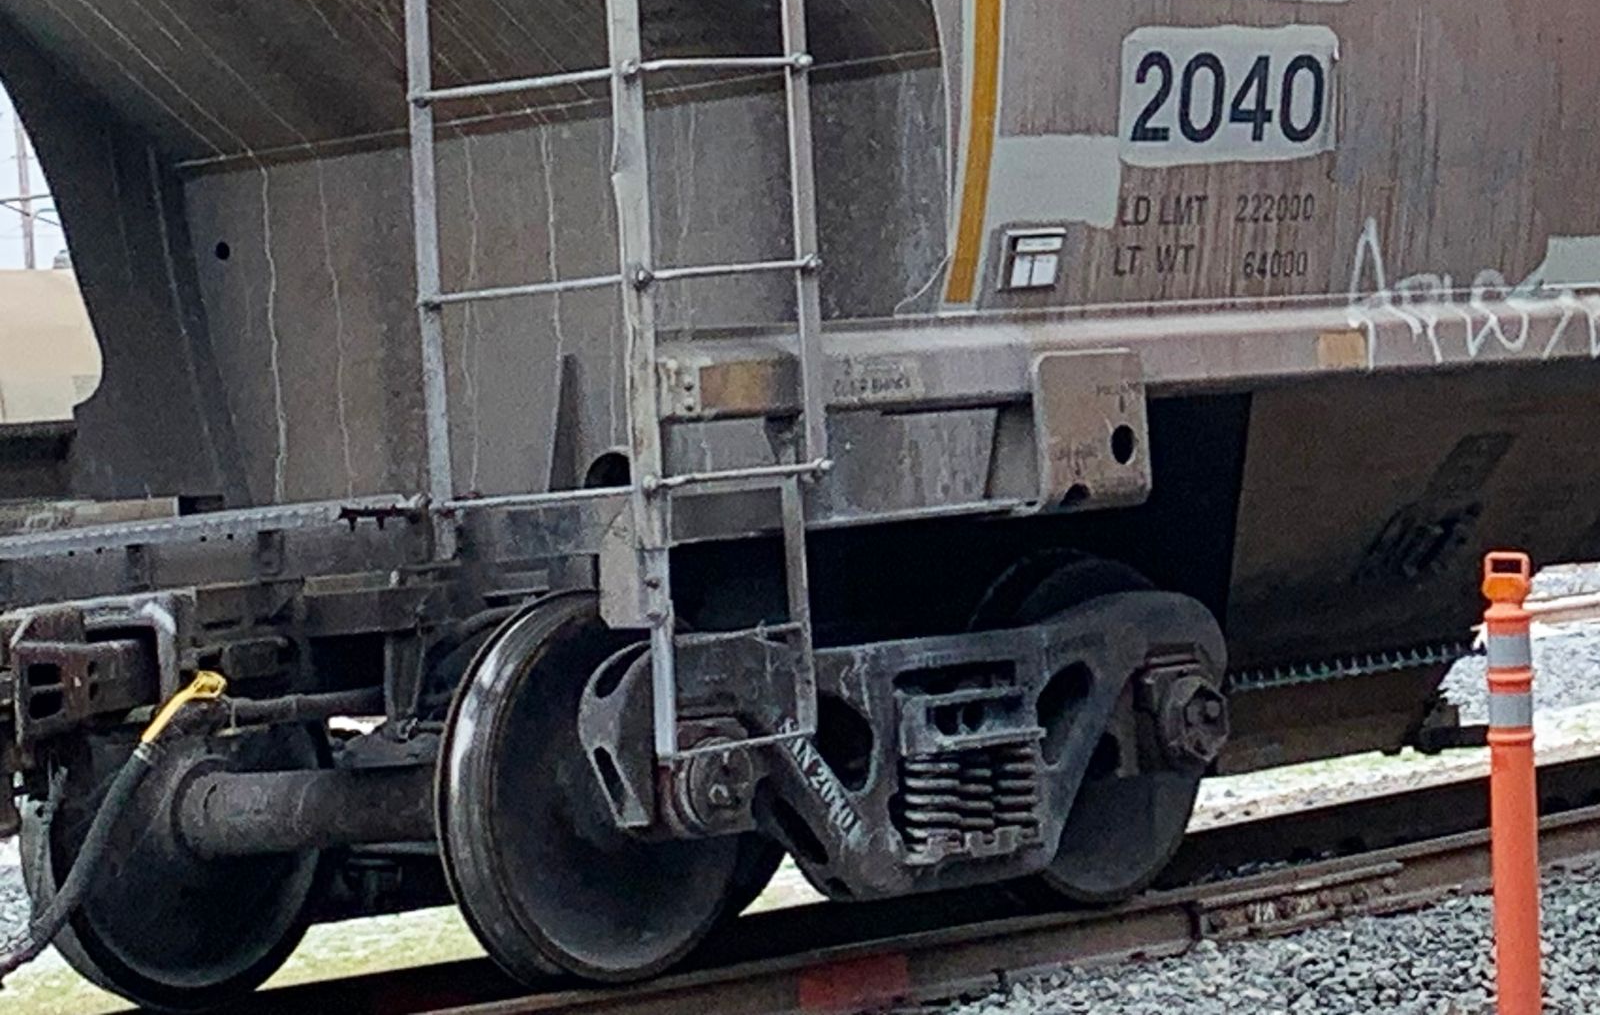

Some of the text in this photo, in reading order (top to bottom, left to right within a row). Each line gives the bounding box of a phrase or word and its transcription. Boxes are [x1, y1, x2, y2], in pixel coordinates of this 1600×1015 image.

[1130, 50, 1326, 143] 2040
[1120, 192, 1315, 227] LD LMT 222000
[1113, 244, 1308, 280] LT WT 64000
